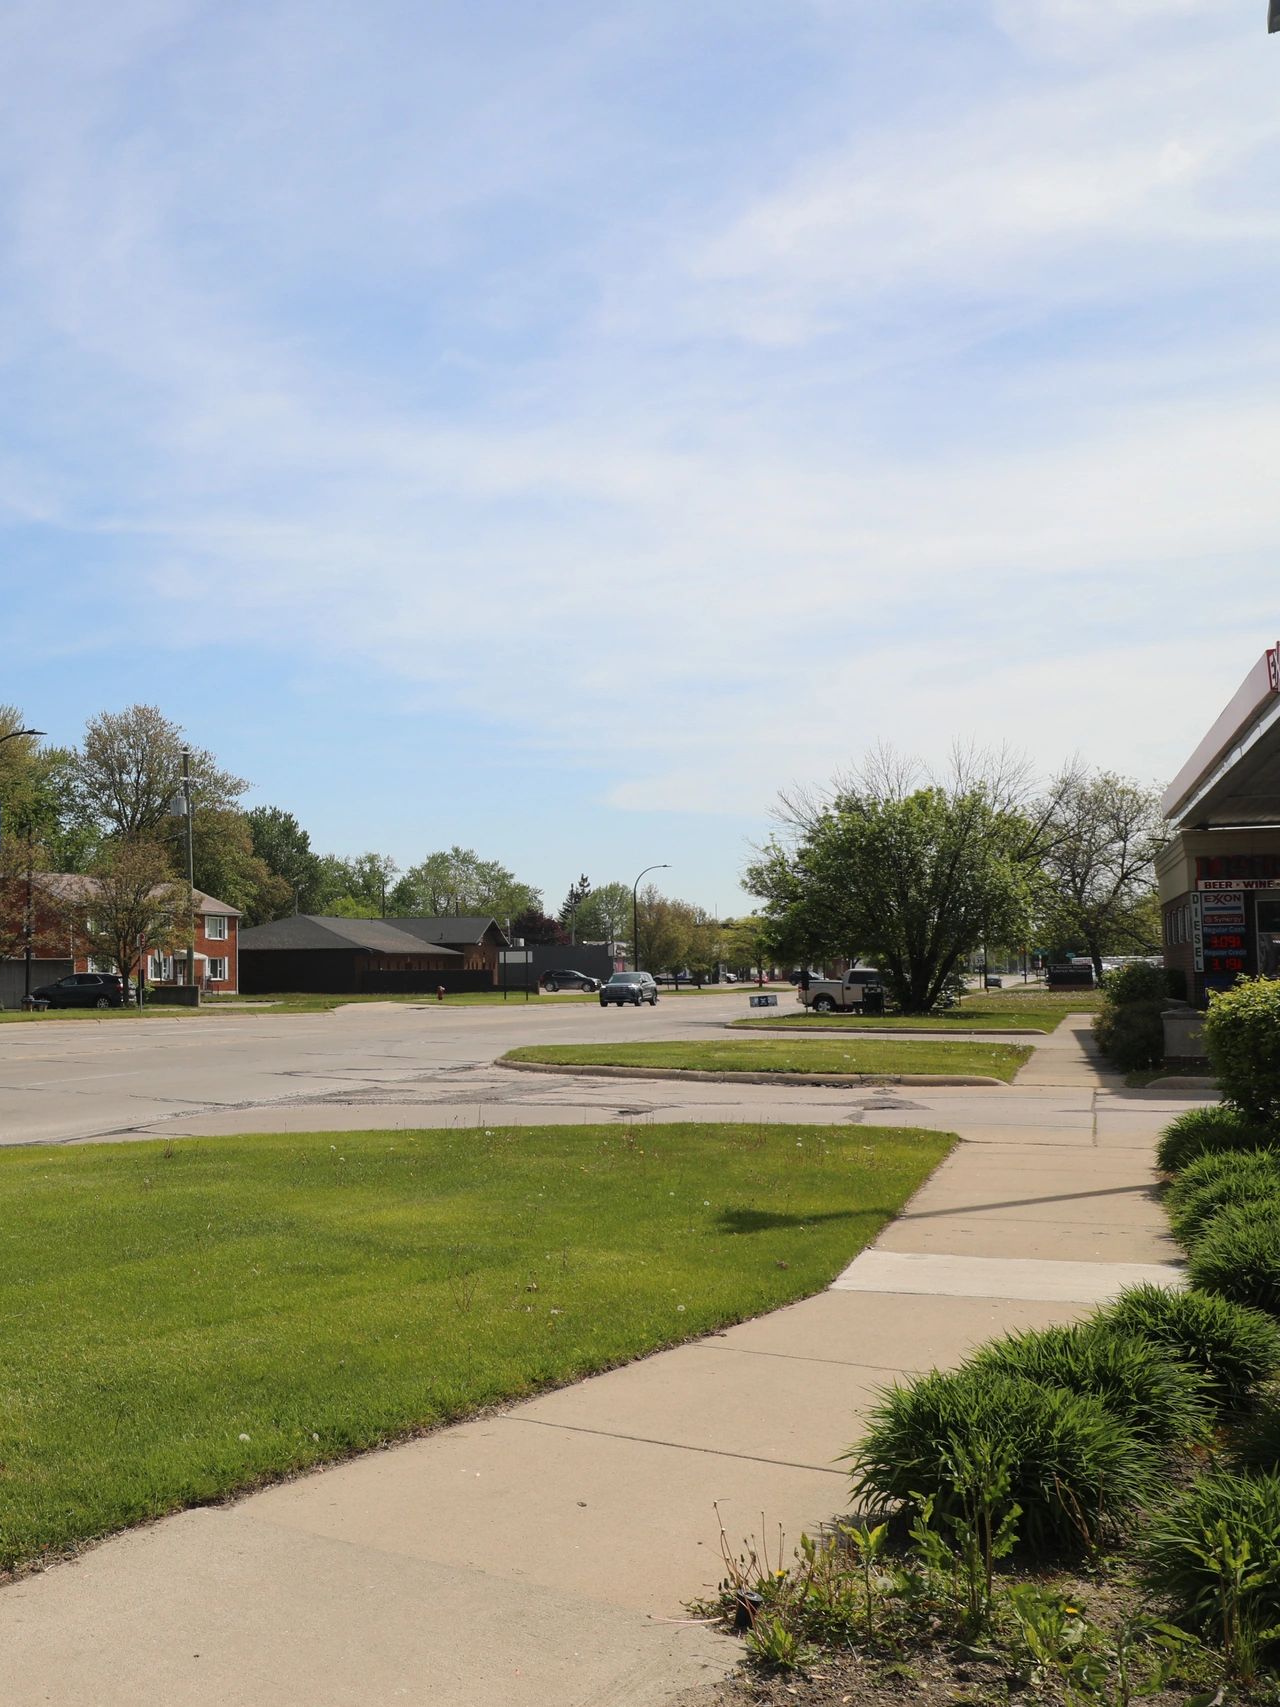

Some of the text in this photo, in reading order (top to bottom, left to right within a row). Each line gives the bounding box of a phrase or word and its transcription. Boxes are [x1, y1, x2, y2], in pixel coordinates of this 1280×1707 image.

[1243, 880, 1274, 888] WINE
[1204, 893, 1241, 905] EXXON
[1192, 894, 1203, 971] DIESEL
